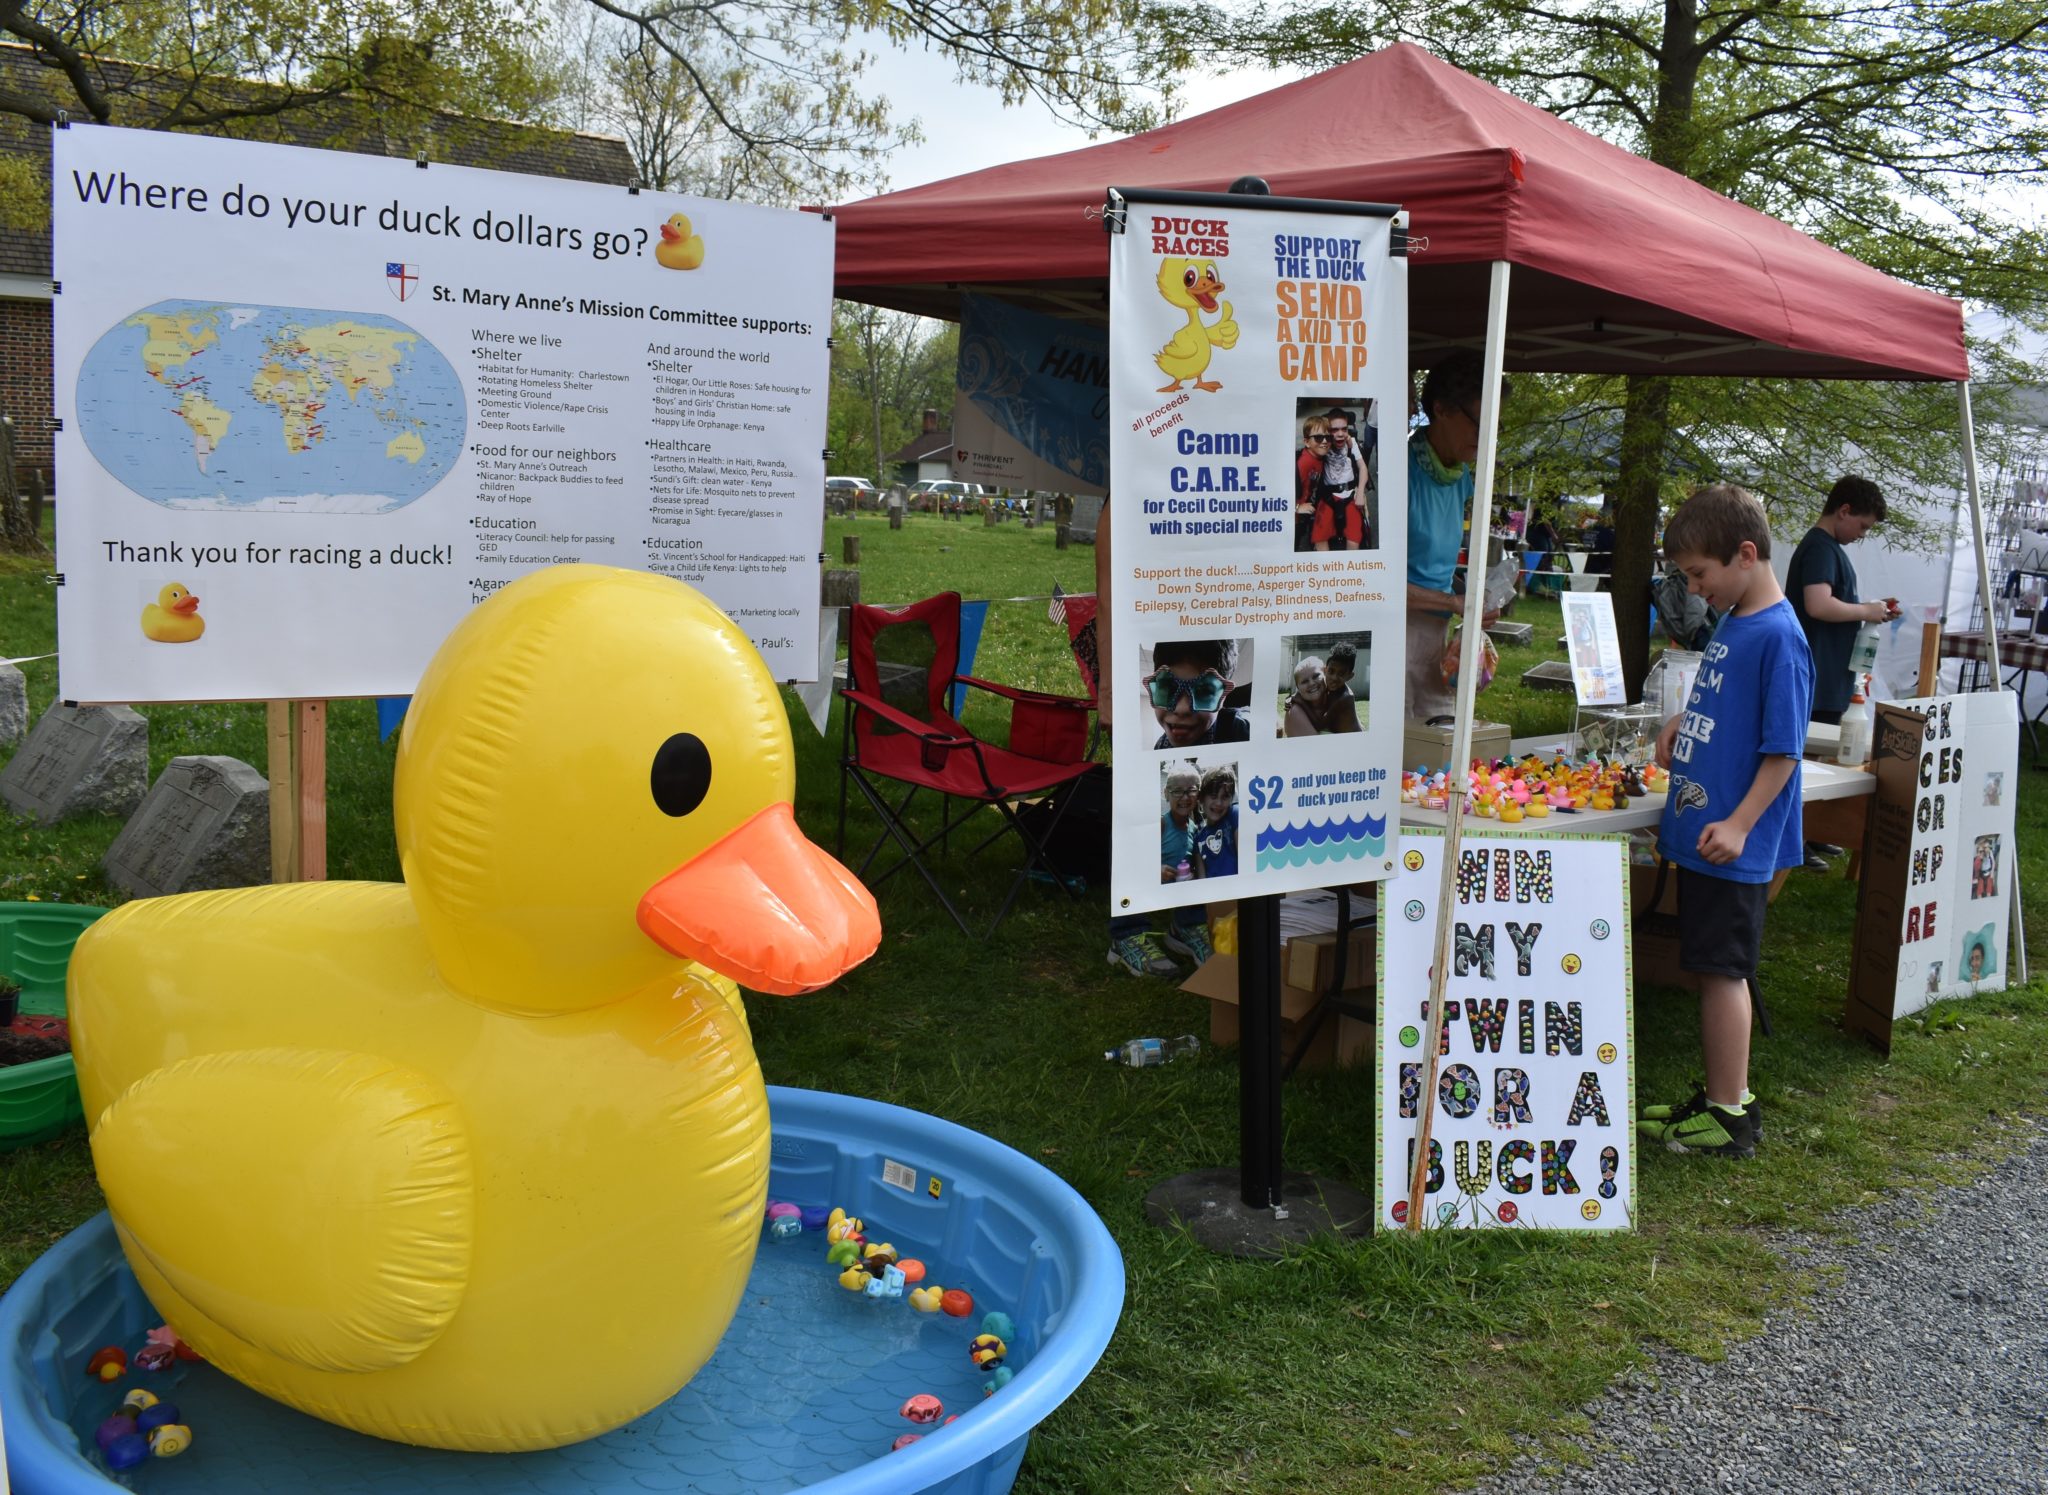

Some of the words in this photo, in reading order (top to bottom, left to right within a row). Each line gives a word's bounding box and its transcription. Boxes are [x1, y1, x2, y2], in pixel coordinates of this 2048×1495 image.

[73, 170, 208, 212] Where
[222, 183, 270, 217] do
[282, 198, 367, 228] your
[378, 200, 460, 238] duck
[473, 210, 582, 250] dollars
[593, 228, 648, 260] go?
[1151, 216, 1229, 238] DUCK
[1152, 236, 1229, 257] RACES
[1274, 234, 1361, 260] SUPPORT
[1275, 257, 1310, 278] THE
[1316, 259, 1366, 281] DUCK
[1276, 280, 1362, 320] SEND
[432, 286, 456, 303] St.
[463, 288, 510, 310] Mary
[580, 299, 644, 319] Mission
[649, 305, 738, 328] Committee
[742, 316, 812, 336] supports:
[472, 329, 515, 343] Where
[519, 335, 537, 345] we
[541, 334, 562, 347] live
[1277, 319, 1292, 342] A
[1298, 319, 1332, 344] KID
[1338, 320, 1366, 344] TO
[477, 347, 522, 361] Shelter
[648, 342, 670, 355] And
[674, 345, 714, 359] around
[718, 348, 736, 360] the
[739, 352, 770, 363] world
[1278, 343, 1368, 382] CAMP
[482, 364, 513, 374] Habitat
[516, 366, 528, 375] for
[531, 368, 574, 379] Humanity:
[579, 371, 629, 381] Charlestown
[652, 360, 692, 373] Shelter
[1038, 346, 1109, 388] HAN
[481, 388, 517, 398] Meeting
[520, 390, 551, 399] Ground
[482, 376, 518, 387] Rotating
[520, 378, 561, 388] Homeless
[564, 381, 593, 390] Shelter
[481, 399, 521, 409] Domestic
[524, 402, 585, 413] Violence/Rape
[587, 405, 608, 414] Crisis
[481, 410, 510, 418] Center
[1132, 417, 1144, 432] all
[1145, 392, 1190, 425] proceeds
[481, 421, 503, 431] Deep
[506, 422, 530, 431] Roots
[532, 424, 565, 433] Earlville
[655, 418, 680, 428] Happy
[682, 419, 695, 427] Life
[698, 420, 741, 430] Orphanage:
[744, 422, 765, 432] Kenya
[1150, 412, 1183, 438] benefit
[476, 444, 506, 456] Food
[511, 445, 528, 457] for
[532, 449, 553, 458] our
[557, 448, 616, 462] neighbors
[650, 439, 711, 452] Healthcare
[1177, 428, 1259, 457] Camp
[480, 460, 491, 469] St.
[494, 461, 516, 471] Mary
[549, 463, 587, 472] Outreach
[973, 453, 1014, 463] THRIVENT
[1170, 466, 1266, 492] C.A.R.E.
[480, 494, 494, 503] Ray
[498, 494, 506, 502] of
[509, 495, 531, 503] Hope
[1143, 499, 1164, 513] for
[1168, 498, 1205, 513] Cecil
[1209, 498, 1259, 514] County
[1262, 498, 1288, 512] kids
[475, 517, 536, 529] Education
[1150, 519, 1182, 535] with
[1186, 519, 1239, 536] special
[1242, 518, 1282, 533] needs
[479, 533, 512, 542] Literacy
[515, 534, 548, 542] Council:
[551, 534, 569, 543] help
[585, 536, 615, 544] passing
[479, 543, 497, 551] GED
[648, 538, 702, 549] Education
[103, 541, 184, 563] Thank
[192, 547, 237, 567] you
[246, 542, 281, 563] for
[290, 545, 362, 569] racing
[370, 548, 381, 564] a
[390, 544, 452, 565] duck!
[479, 555, 506, 563] Family
[510, 555, 550, 563] Education
[651, 553, 661, 561] St.
[700, 553, 725, 561] School
[727, 553, 737, 561] for
[739, 554, 787, 563] Handicapped:
[1134, 567, 1181, 581] Support
[1184, 566, 1202, 578] the
[1296, 562, 1319, 573] kids
[1322, 561, 1343, 572] with
[1347, 560, 1386, 572] Autism,
[1158, 583, 1192, 594] Down
[1195, 581, 1254, 596] Syndrome,
[1258, 579, 1304, 592] Asperger
[1309, 576, 1365, 590] Syndrome,
[741, 609, 776, 617] Marketing
[778, 609, 800, 617] locally
[1135, 600, 1187, 614] Epilepsy,
[1191, 597, 1238, 610] Cerebral
[1242, 596, 1271, 609] Palsy,
[1276, 593, 1332, 606] Blindness,
[1336, 591, 1385, 603] Deafness,
[1180, 613, 1231, 626] Muscular
[1235, 610, 1289, 625] Dystrophy
[1293, 610, 1314, 621] and
[1317, 609, 1346, 619] more.
[1292, 774, 1313, 789] and
[1316, 774, 1336, 788] you
[1339, 770, 1366, 786] keep
[1368, 768, 1386, 780] the
[1919, 748, 1962, 788] CES
[1248, 775, 1284, 814] $2
[1298, 792, 1326, 808] duck
[1328, 791, 1348, 806] you
[1351, 787, 1379, 801] race!
[1917, 794, 1945, 833] OR
[1912, 845, 1943, 886] MP
[1457, 849, 1554, 904] WIN
[1903, 901, 1937, 946] RE
[1454, 922, 1543, 981] MY
[1420, 998, 1583, 1056] TWIN
[1399, 1063, 1534, 1124] FOR
[1567, 1071, 1611, 1127] A
